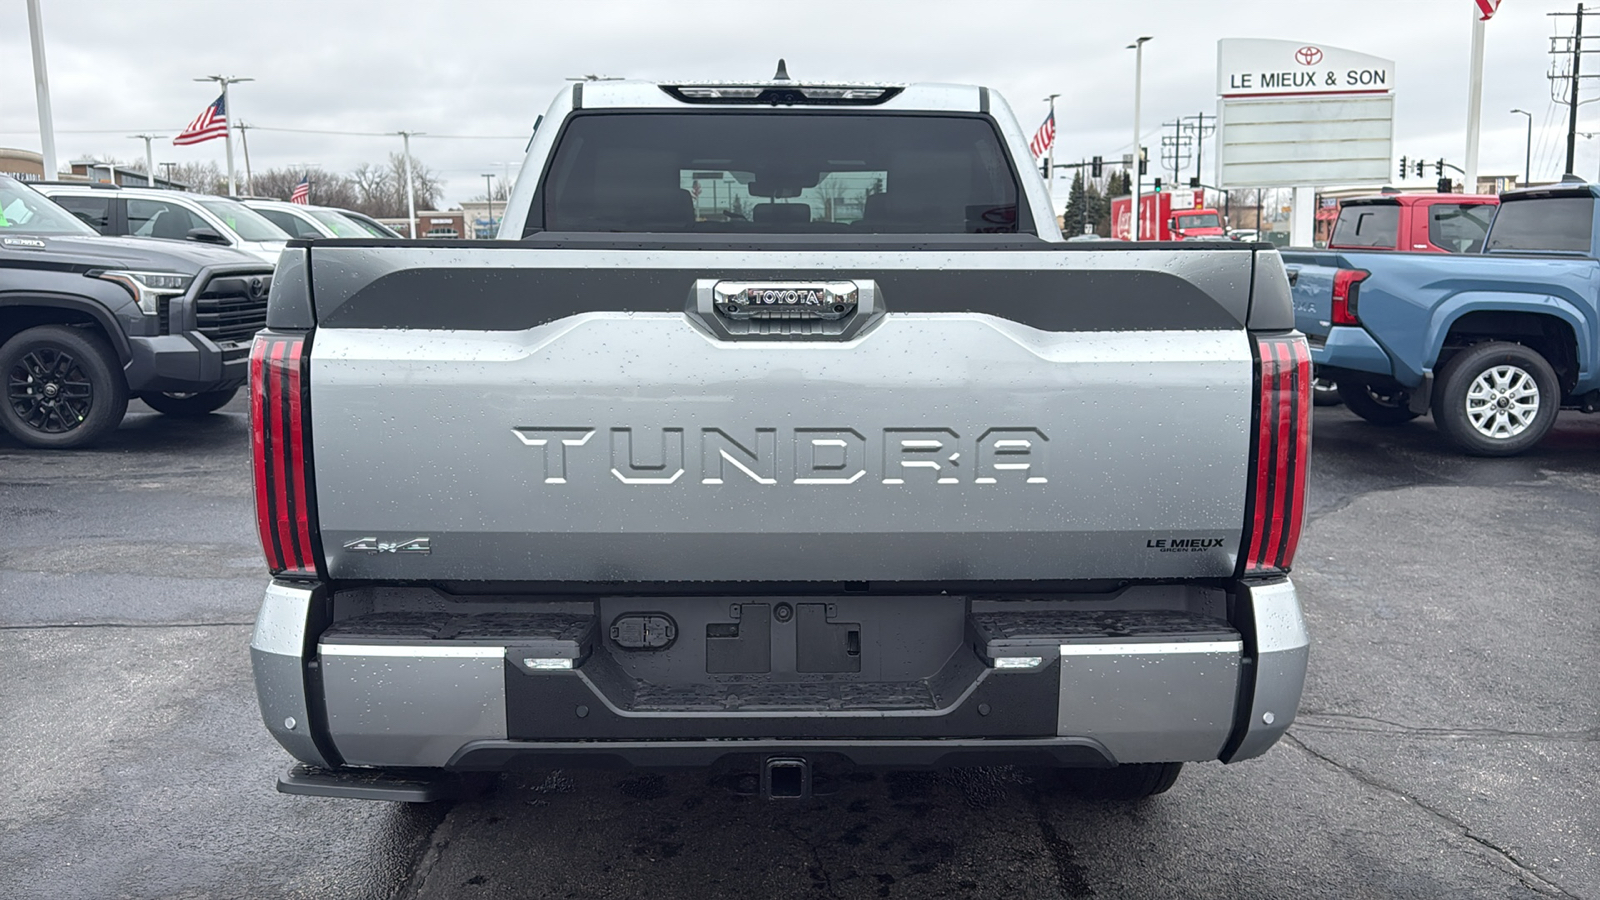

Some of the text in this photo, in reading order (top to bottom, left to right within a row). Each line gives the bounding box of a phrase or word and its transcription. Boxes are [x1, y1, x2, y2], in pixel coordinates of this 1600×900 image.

[1231, 70, 1386, 89] LE MIEUX & SON
[753, 290, 820, 306] TOYOTA
[511, 426, 1050, 485] TUNDRA
[1146, 538, 1224, 548] LE MIEUX
